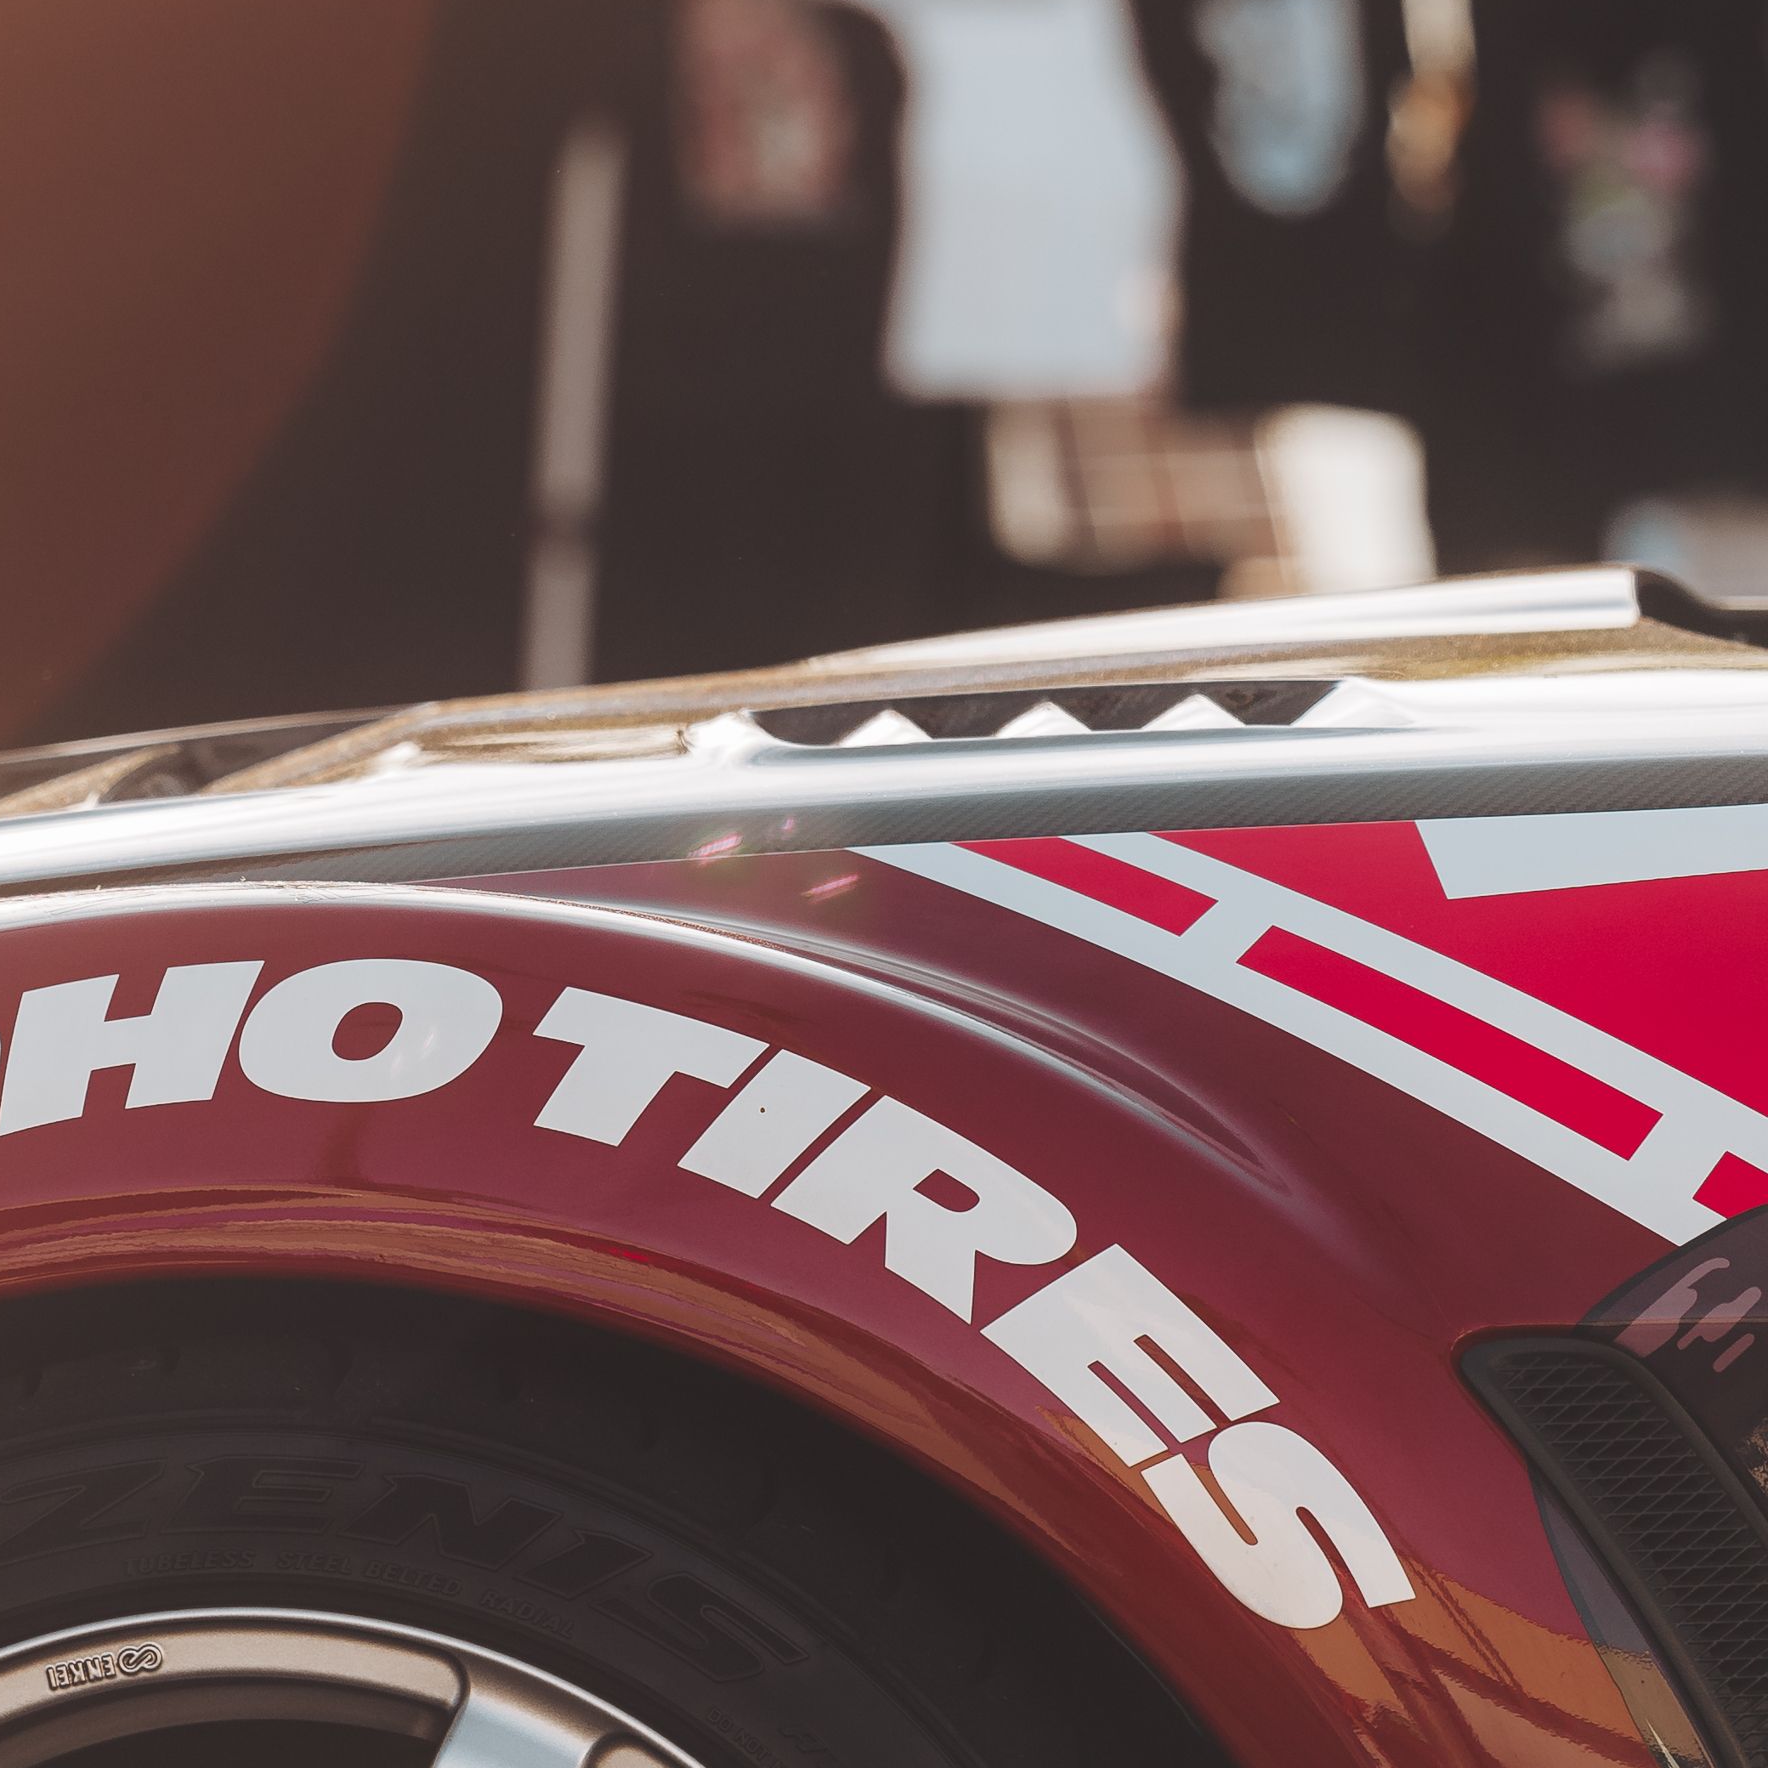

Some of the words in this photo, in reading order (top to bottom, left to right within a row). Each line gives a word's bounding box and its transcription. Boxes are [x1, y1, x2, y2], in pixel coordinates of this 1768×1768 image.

[533, 987, 1415, 1628] TIRES
[125, 1549, 256, 1578] TUBELESS
[275, 1549, 354, 1576] STEEL
[364, 1559, 466, 1598] BELTED
[479, 1589, 575, 1637] RADIAL
[46, 1653, 117, 1691] ENKEI
